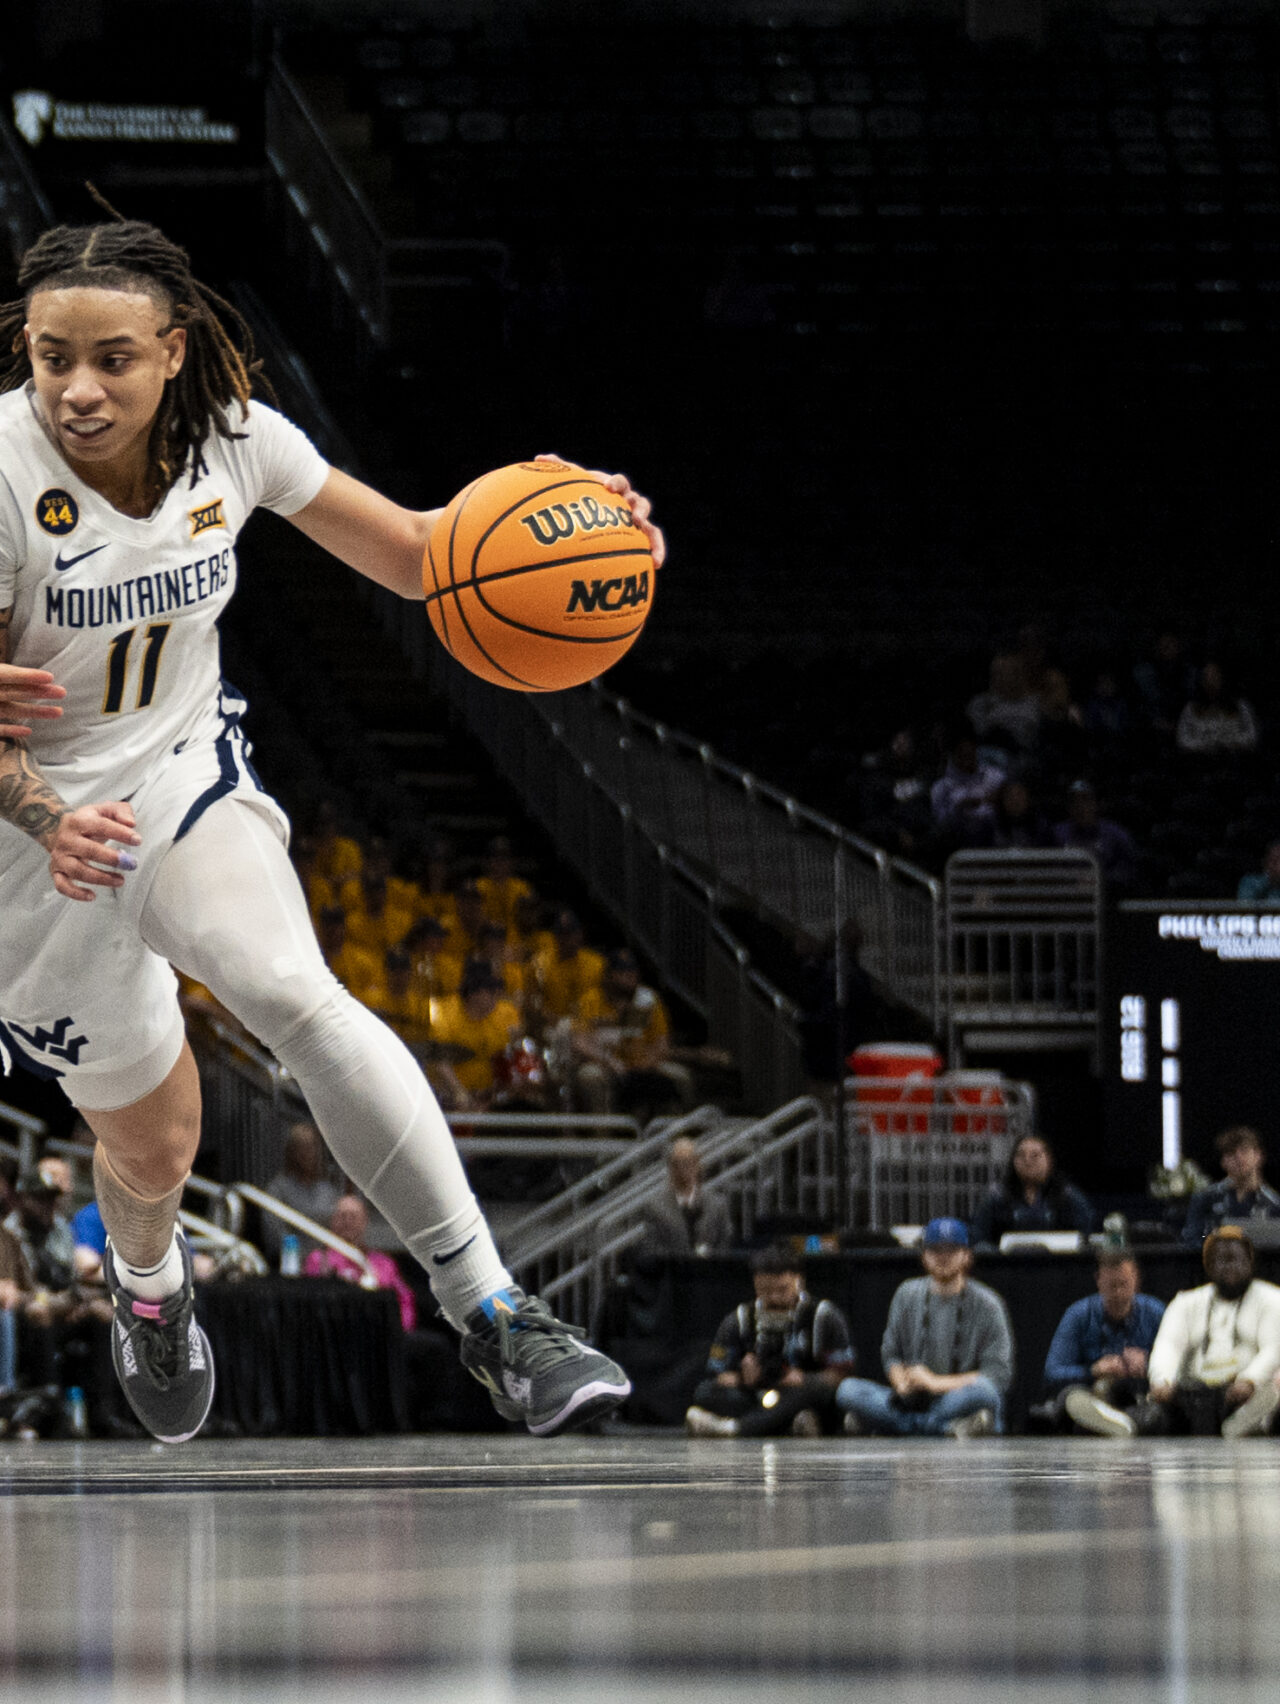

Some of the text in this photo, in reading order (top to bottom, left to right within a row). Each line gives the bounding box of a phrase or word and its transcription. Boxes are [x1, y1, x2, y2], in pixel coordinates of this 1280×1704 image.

[44, 504, 73, 526] 44
[520, 495, 642, 546] Wilso
[45, 548, 229, 628] MOUNTAINEERS
[566, 570, 648, 613] NCAA
[101, 621, 172, 715] 11
